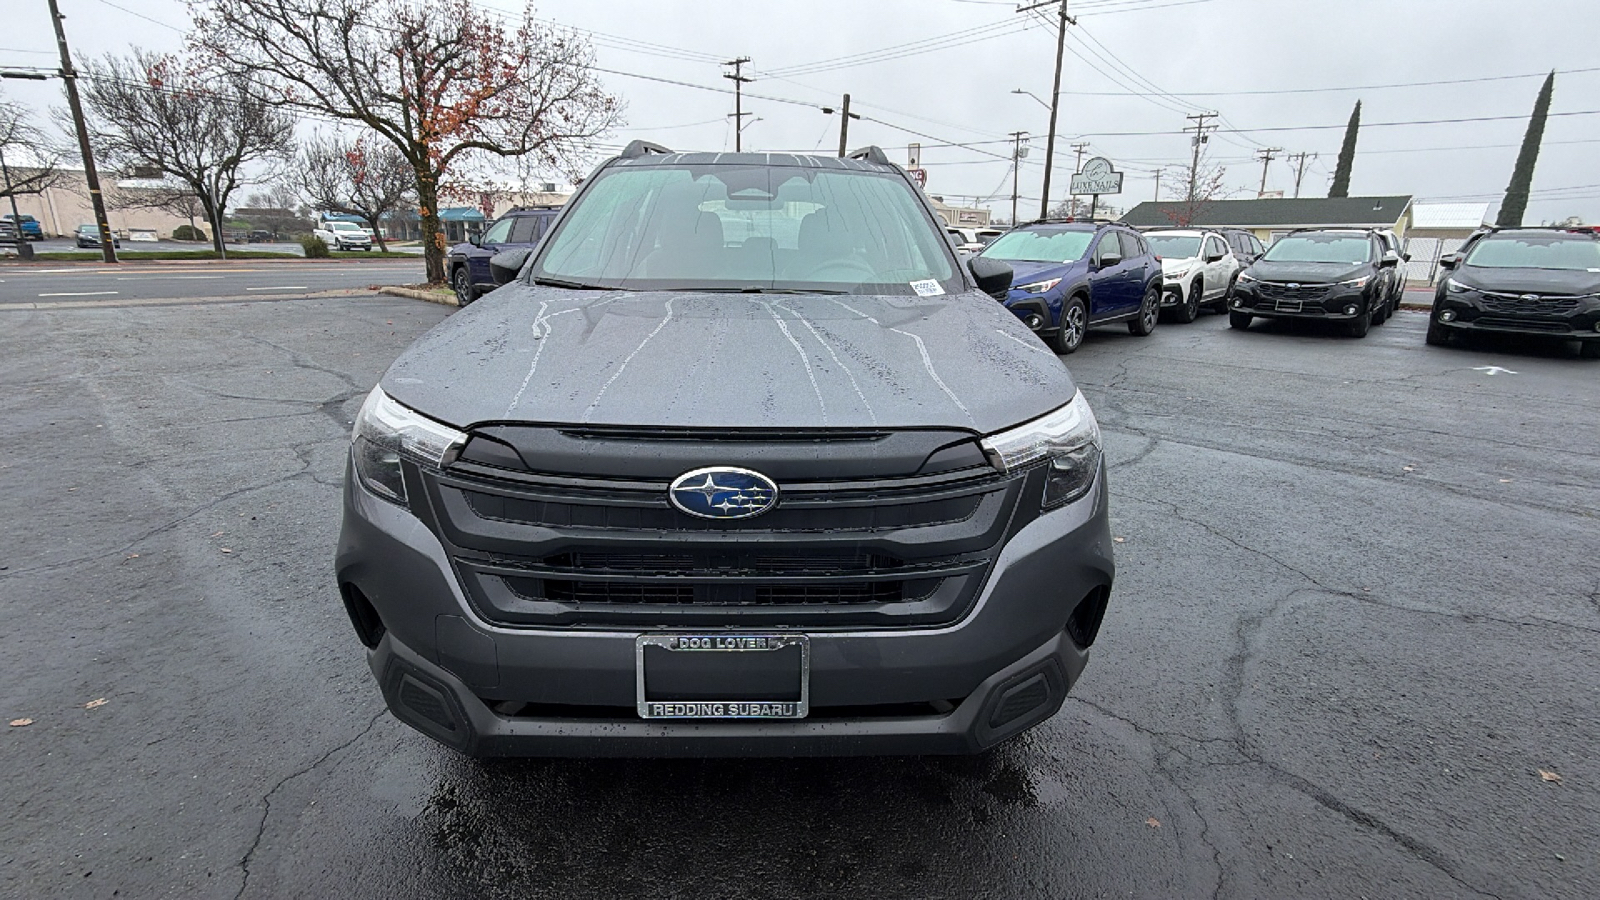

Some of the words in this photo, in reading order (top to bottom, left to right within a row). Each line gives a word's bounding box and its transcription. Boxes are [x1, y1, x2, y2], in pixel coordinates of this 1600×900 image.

[1072, 181, 1092, 190] LUXE
[1095, 180, 1119, 189] NAILS
[680, 638, 711, 648] DOG
[717, 638, 766, 648] LOVER
[653, 704, 723, 716] REDDING
[728, 704, 793, 716] SUBARU
